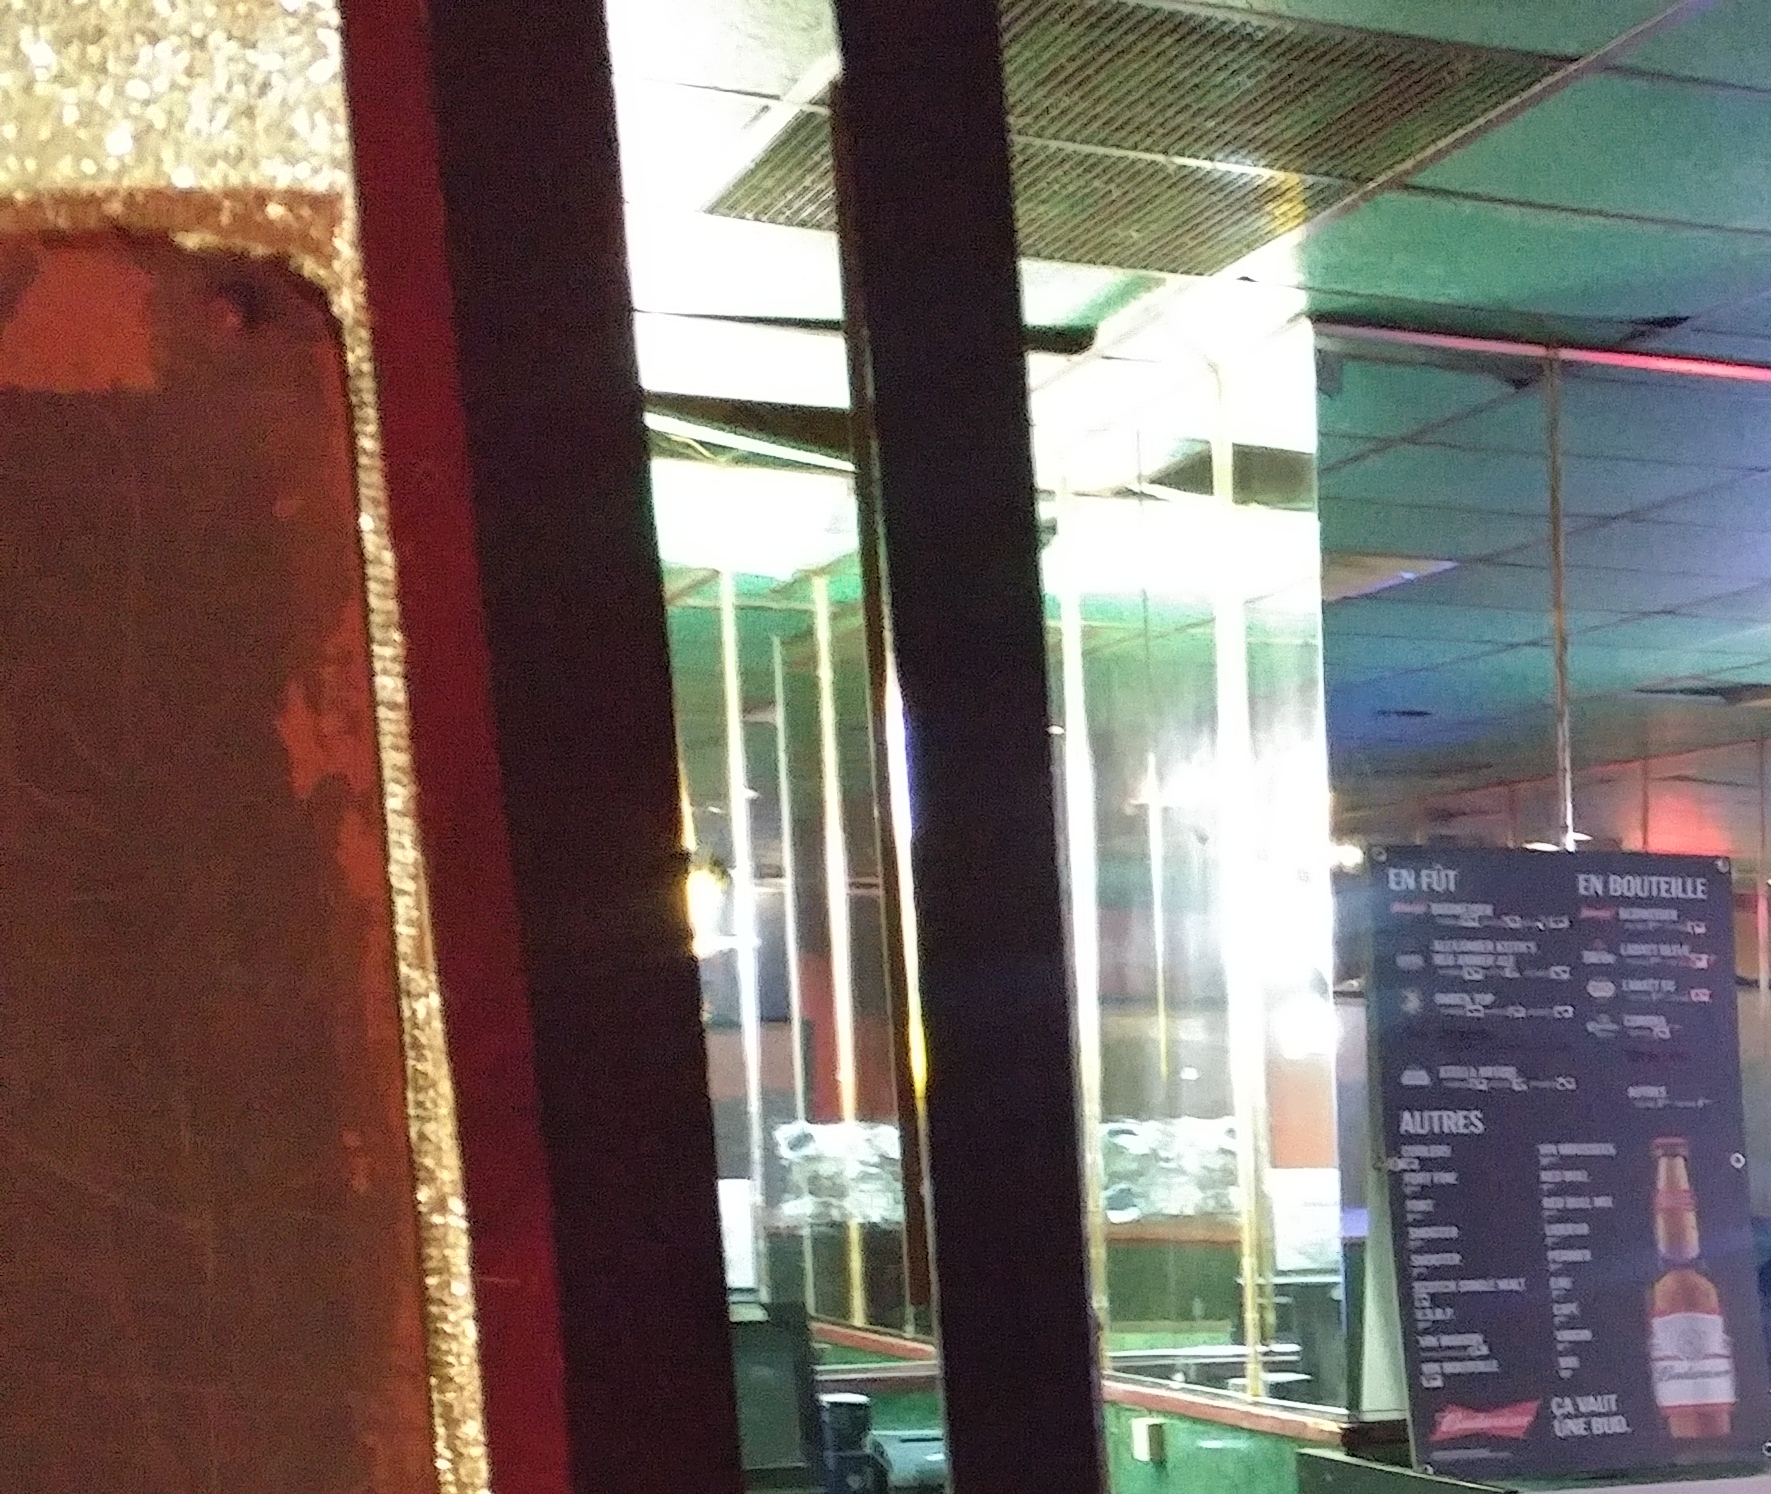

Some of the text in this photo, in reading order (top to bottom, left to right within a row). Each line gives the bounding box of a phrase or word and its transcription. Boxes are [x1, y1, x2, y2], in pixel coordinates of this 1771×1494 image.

[1387, 864, 1459, 893] EN FÛT
[1577, 873, 1708, 900] EN BOUTEILLE
[1399, 1109, 1486, 1135] AUTRES
